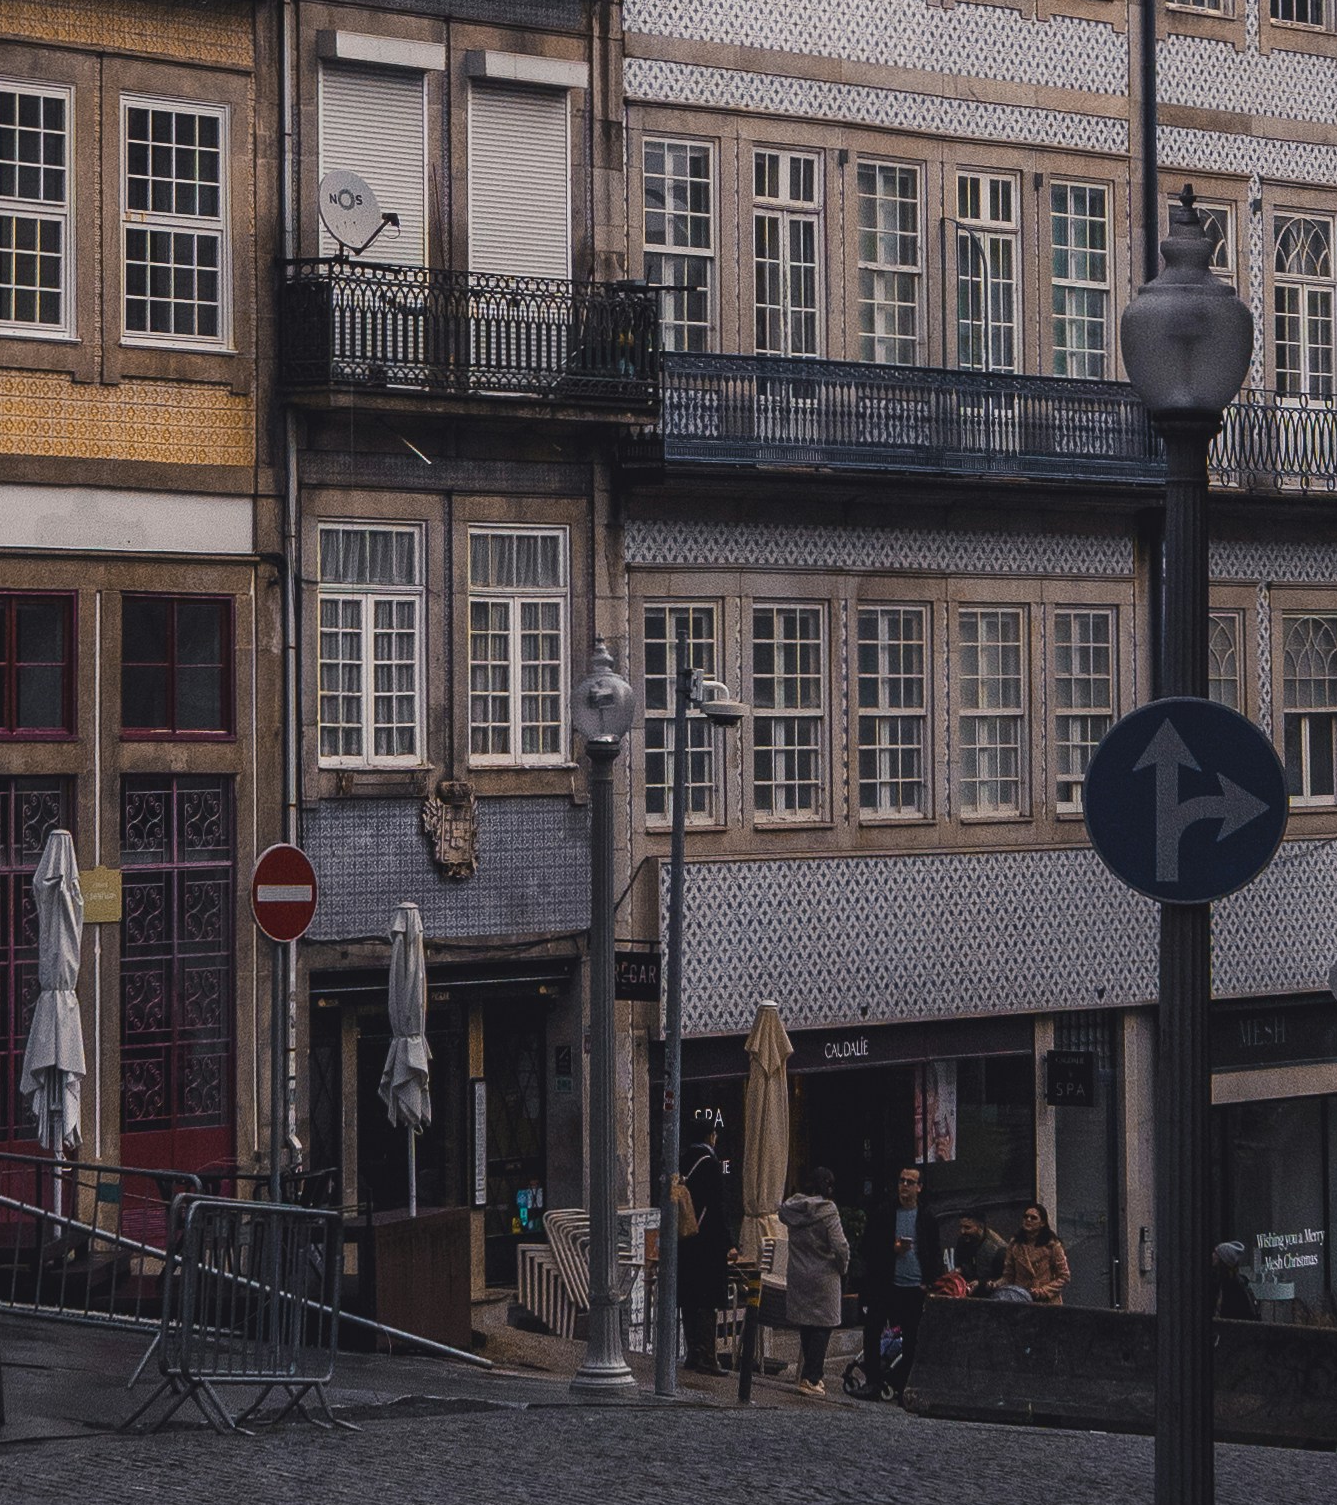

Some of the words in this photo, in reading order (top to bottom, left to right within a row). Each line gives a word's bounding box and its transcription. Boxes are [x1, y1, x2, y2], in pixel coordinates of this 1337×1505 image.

[328, 188, 364, 211] NOS
[1238, 1016, 1286, 1048] MESH
[1055, 1082, 1086, 1097] SPA
[1256, 1232, 1284, 1251] Wishing
[1304, 1228, 1325, 1246] Merry
